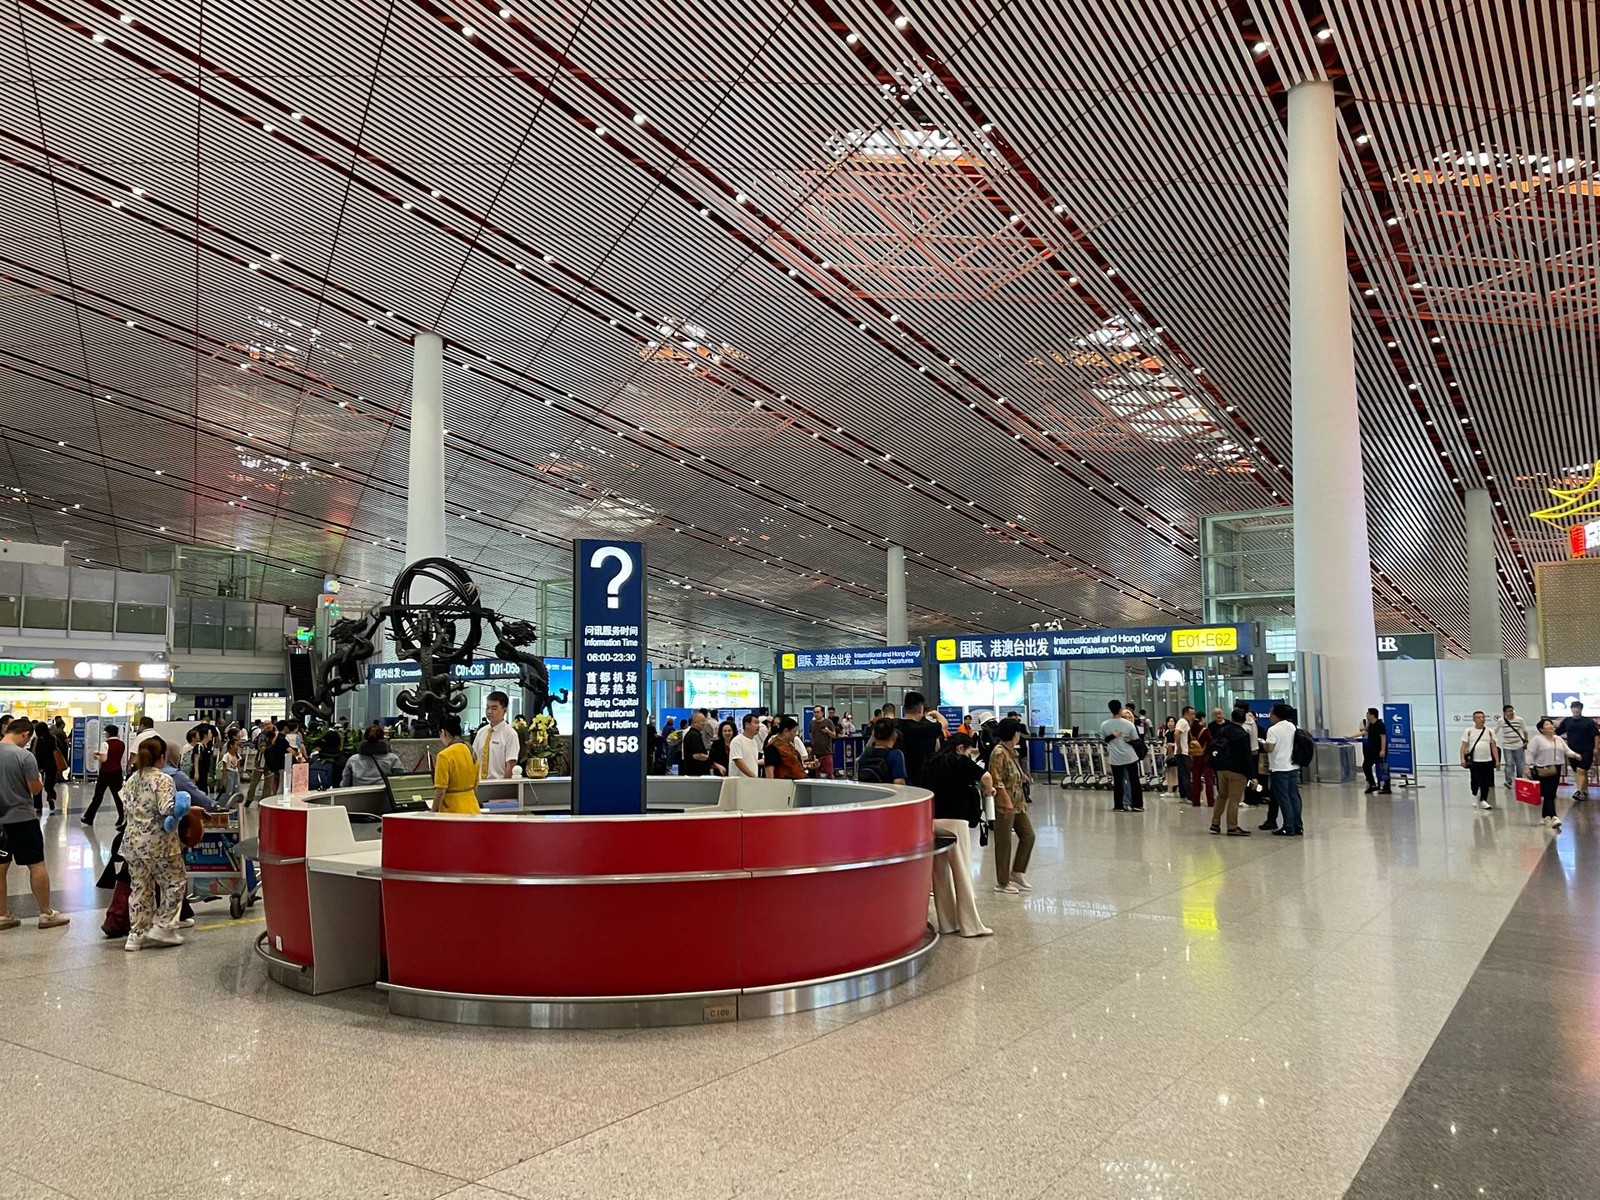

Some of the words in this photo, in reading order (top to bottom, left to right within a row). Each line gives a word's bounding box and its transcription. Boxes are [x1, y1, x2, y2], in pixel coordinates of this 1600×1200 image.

[584, 625, 638, 636] 问讯服务时间
[584, 638, 621, 646] Information
[622, 638, 638, 646] Time
[1054, 635, 1100, 645] International
[1101, 634, 1118, 644] and
[1118, 634, 1140, 644] Hong
[1142, 632, 1167, 644] Kong/
[1177, 632, 1231, 648] E01-E62
[1054, 646, 1110, 656] Macao/Taiwan
[1110, 644, 1156, 654] Departures
[586, 653, 636, 662] 06:00-23:30
[586, 672, 638, 683] 首都机场
[586, 684, 638, 694] 服务热线
[584, 698, 610, 708] Beijing
[612, 698, 639, 708] Capital
[588, 709, 636, 718] International
[584, 720, 610, 731] Airport
[612, 720, 639, 729] Hotline
[584, 736, 638, 754] 96158
